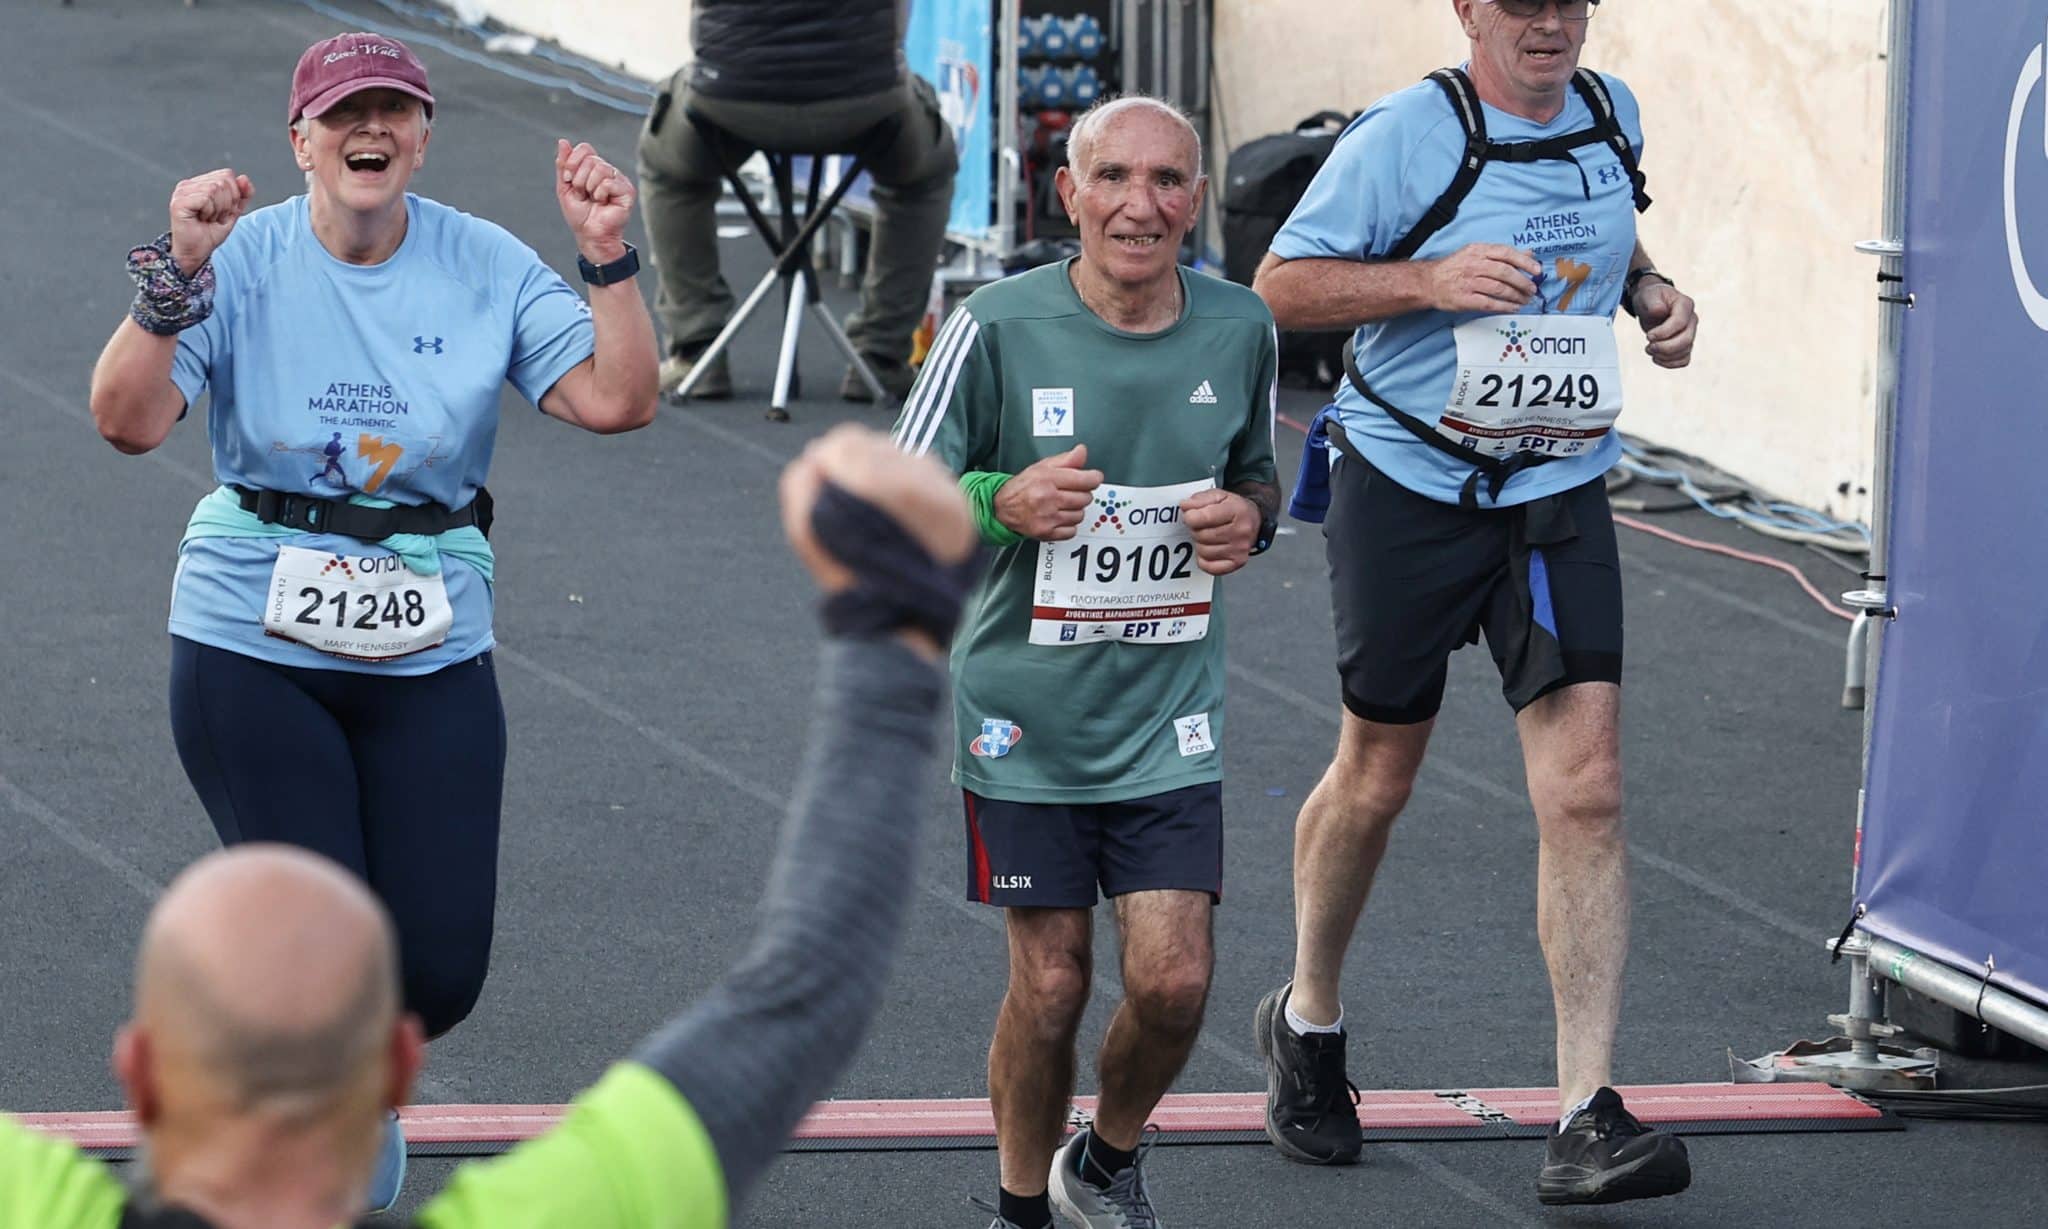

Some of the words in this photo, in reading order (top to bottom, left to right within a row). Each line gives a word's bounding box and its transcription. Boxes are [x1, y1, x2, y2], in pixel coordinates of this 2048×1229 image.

[1525, 212, 1580, 231] ATHENS
[1513, 224, 1597, 246] MARATHON
[1544, 242, 1588, 253] AUTHENTIC
[326, 383, 392, 399] ATHENS
[1189, 394, 1218, 404] adidas
[1455, 380, 1469, 406] BLOCK
[1475, 374, 1599, 410] 21249
[308, 397, 408, 415] MARATHON
[320, 416, 338, 424] THE
[341, 418, 397, 428] AUTHENTIC
[1044, 548, 1056, 581] BLOCK
[1070, 541, 1193, 583] 19102
[274, 590, 284, 622] BLOCK
[295, 587, 425, 630] 21248
[324, 639, 354, 649] MARY
[357, 641, 408, 652] HENNESSY
